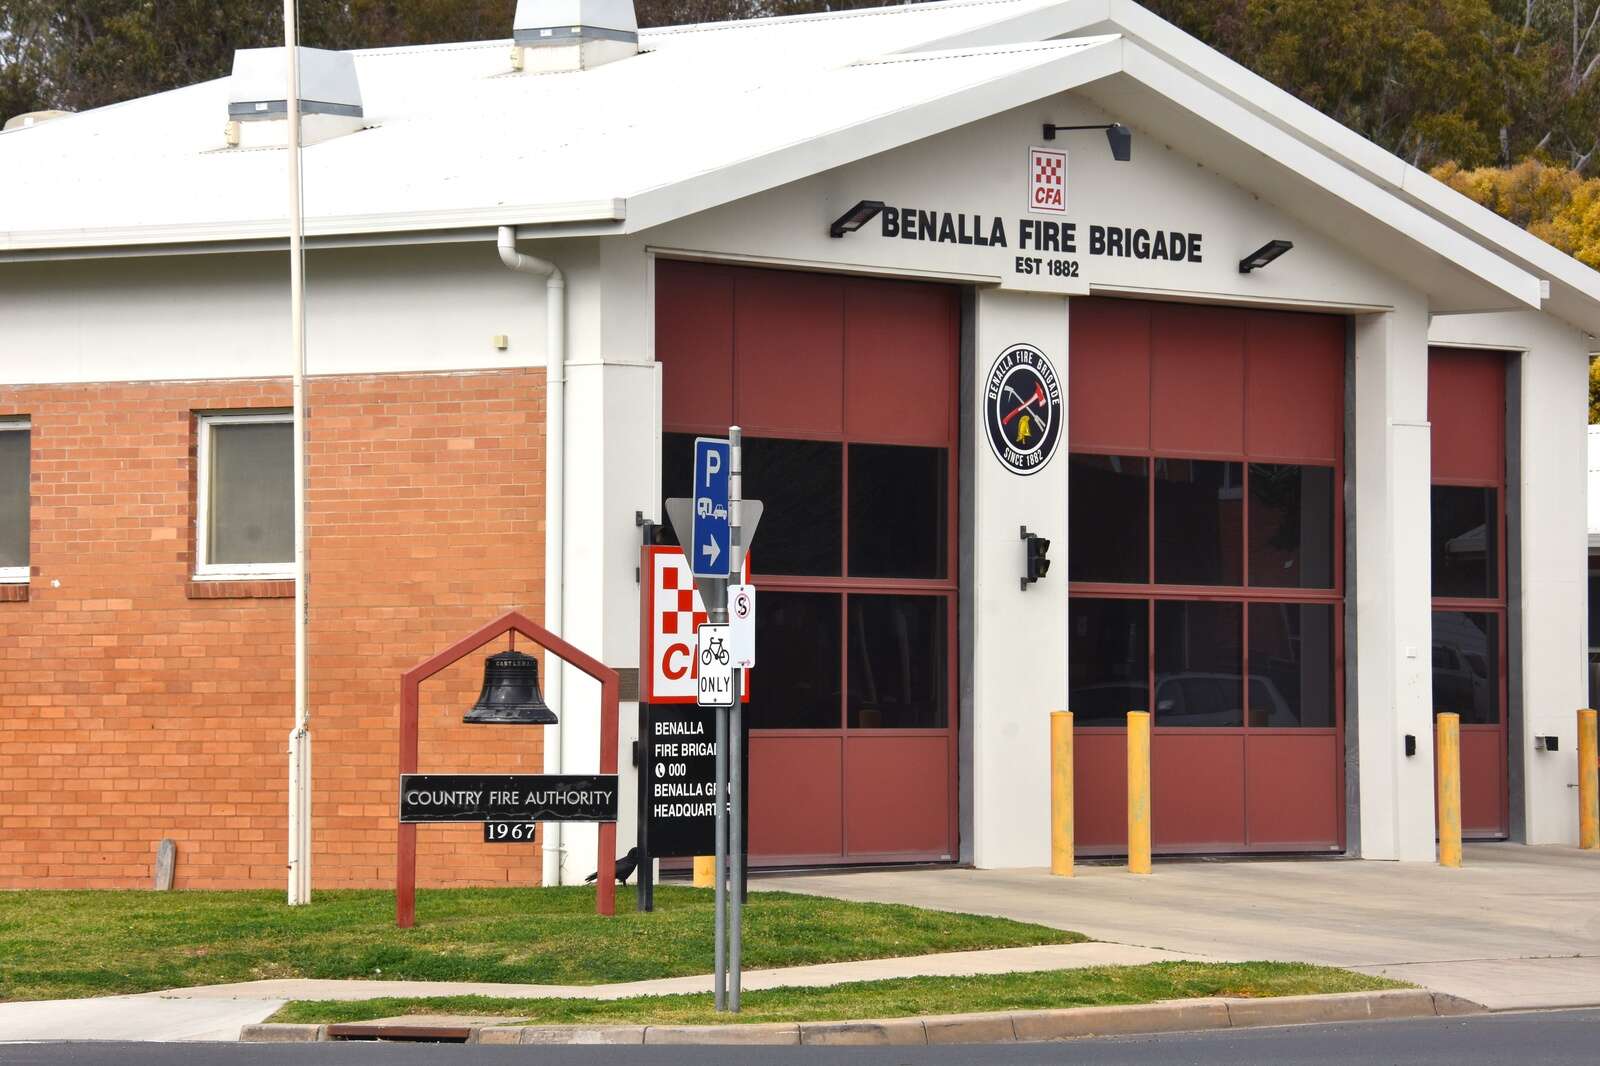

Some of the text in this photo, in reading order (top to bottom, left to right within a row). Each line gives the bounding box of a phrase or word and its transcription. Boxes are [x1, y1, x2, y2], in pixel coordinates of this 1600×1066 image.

[1035, 187, 1062, 205] CFA
[881, 205, 1202, 263] BENALLA FIRE BRIGADE
[1015, 256, 1079, 277] EST 1882
[989, 350, 1060, 406] BENALLA FIRE BRIGADE
[1003, 447, 1044, 467] SINCE 1882
[706, 450, 721, 488] P
[701, 676, 730, 692] ONLY
[655, 721, 704, 735] BENALLA
[655, 743, 717, 757] FIRE BRIGA
[668, 763, 686, 777] 000
[654, 783, 703, 797] BENALLA
[407, 791, 613, 806] COUNTRY FIRE AUTHORITY
[654, 803, 731, 817] HEADQUART
[488, 823, 536, 840] 1967
